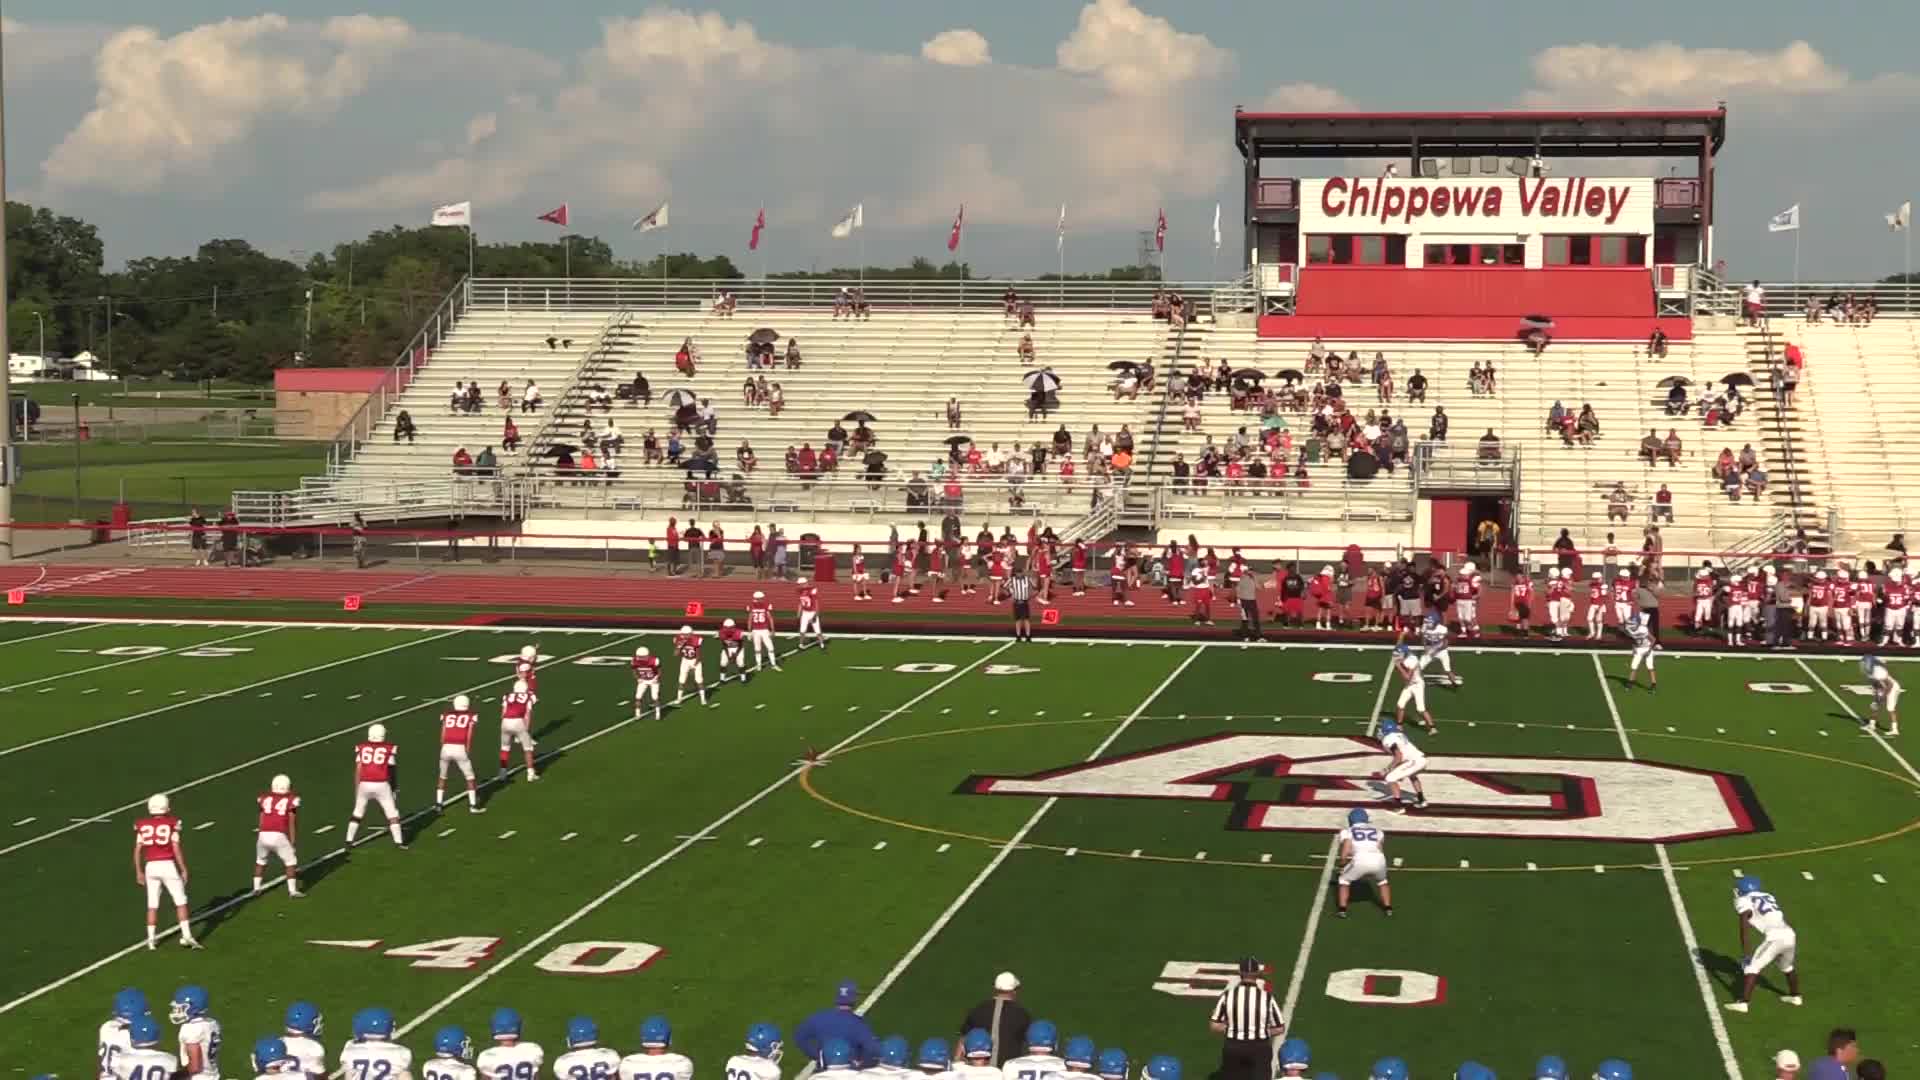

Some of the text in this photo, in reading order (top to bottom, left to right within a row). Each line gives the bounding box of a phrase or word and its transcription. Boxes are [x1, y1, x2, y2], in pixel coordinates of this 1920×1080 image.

[1519, 176, 1631, 225] Valley
[445, 714, 470, 728] 60
[360, 746, 388, 764] 66
[261, 797, 289, 816] 44
[140, 824, 171, 845] 29
[1351, 827, 1378, 842] 62
[352, 1059, 392, 1080] 72
